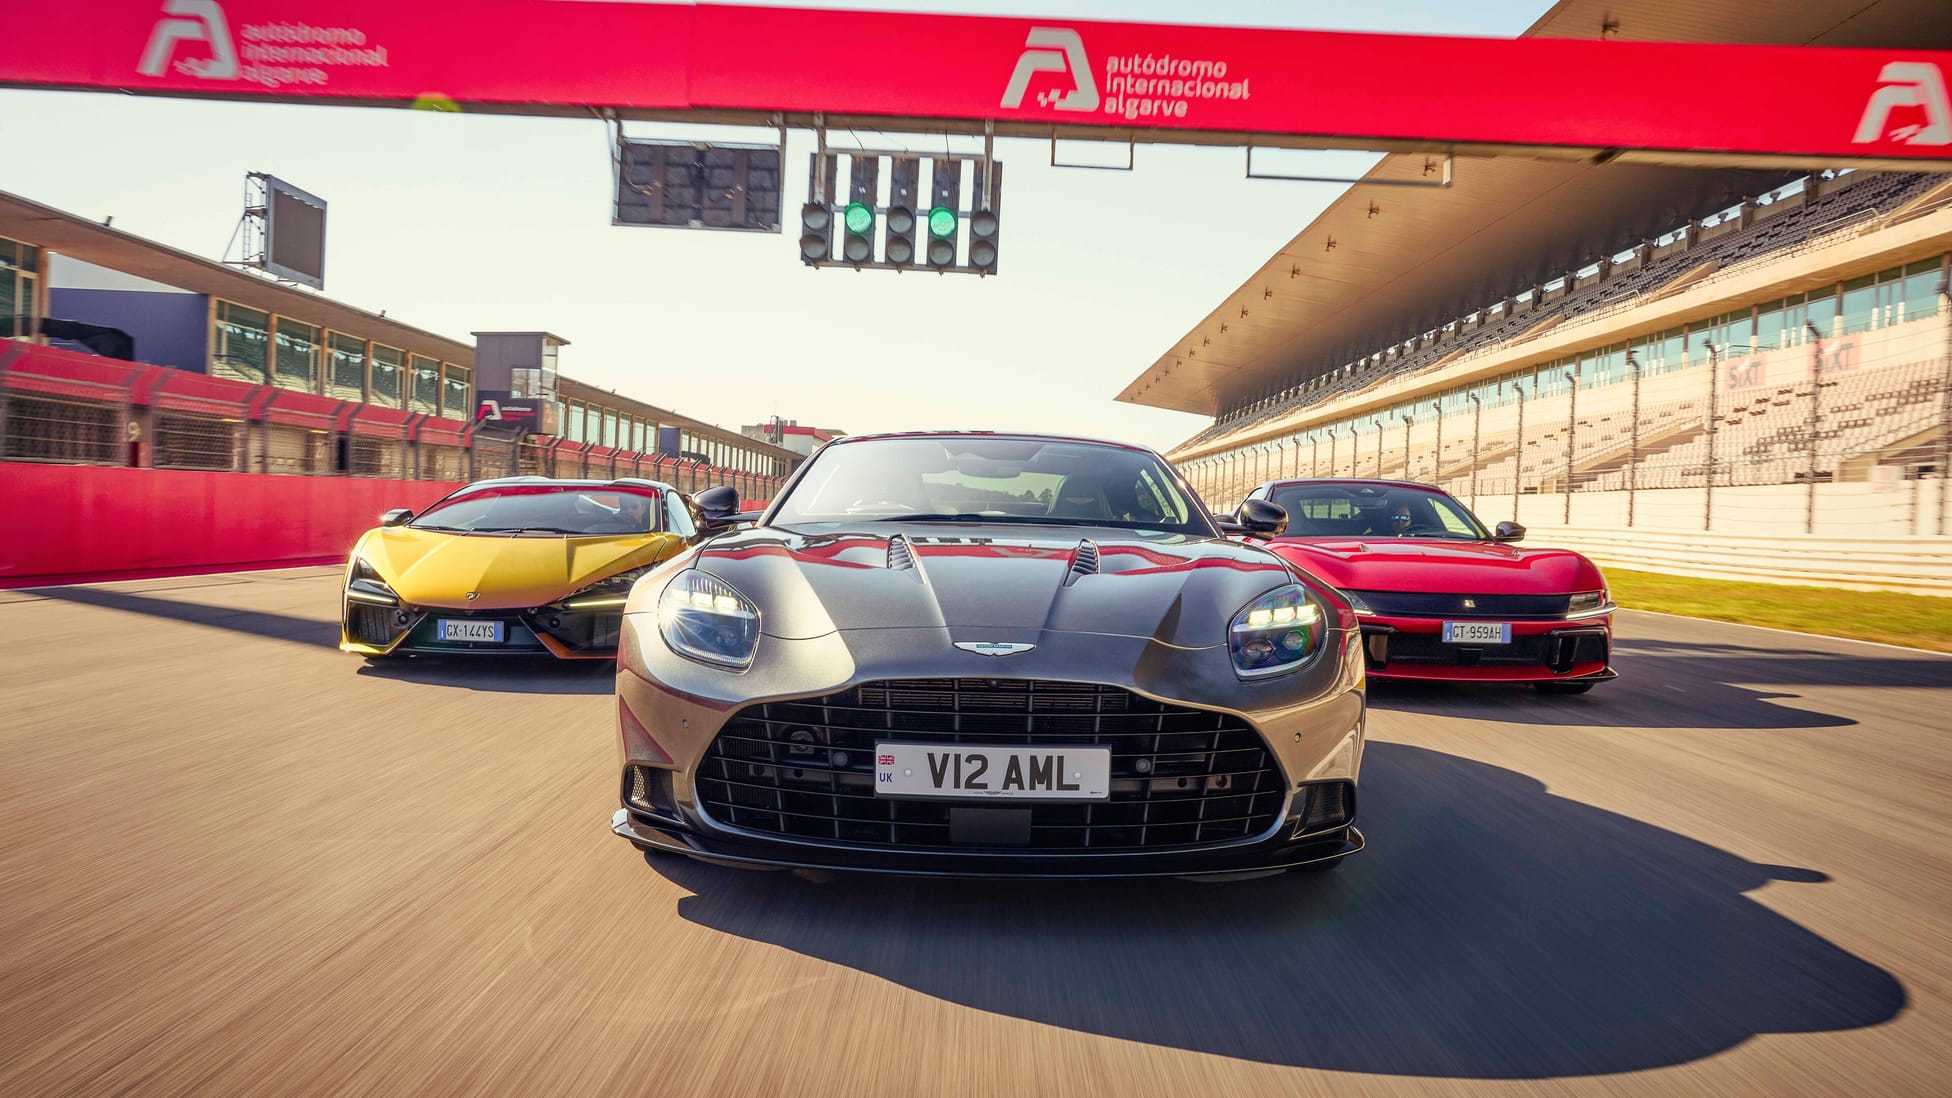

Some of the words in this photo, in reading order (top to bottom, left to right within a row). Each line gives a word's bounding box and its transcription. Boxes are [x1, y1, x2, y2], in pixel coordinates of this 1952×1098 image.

[1106, 53, 1227, 78] autódromo
[1105, 71, 1250, 100] internacional
[1104, 90, 1188, 120] algarve
[879, 772, 893, 783] UK
[927, 752, 989, 789] V12
[1002, 754, 1080, 791] AML
